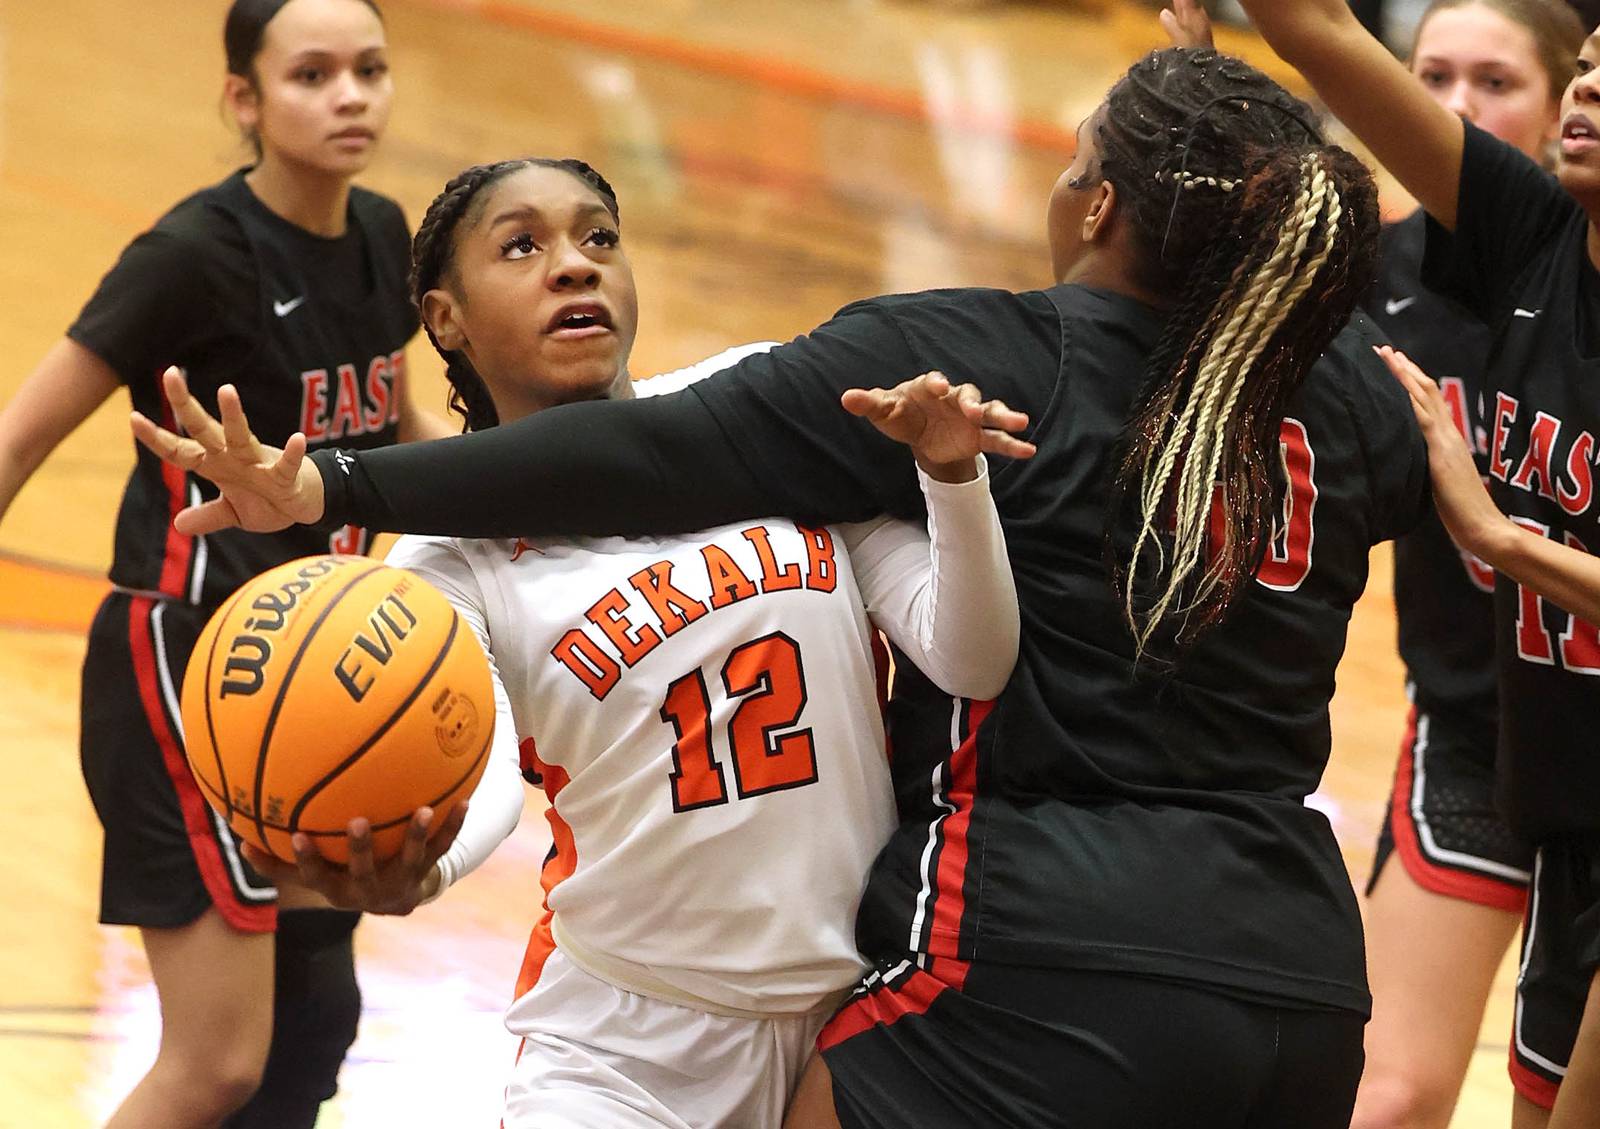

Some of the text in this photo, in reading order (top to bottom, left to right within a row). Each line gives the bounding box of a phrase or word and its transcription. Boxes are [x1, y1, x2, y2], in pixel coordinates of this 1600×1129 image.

[1490, 391, 1600, 520] EAS
[550, 521, 837, 702] DEKALB
[660, 630, 819, 813] 12
